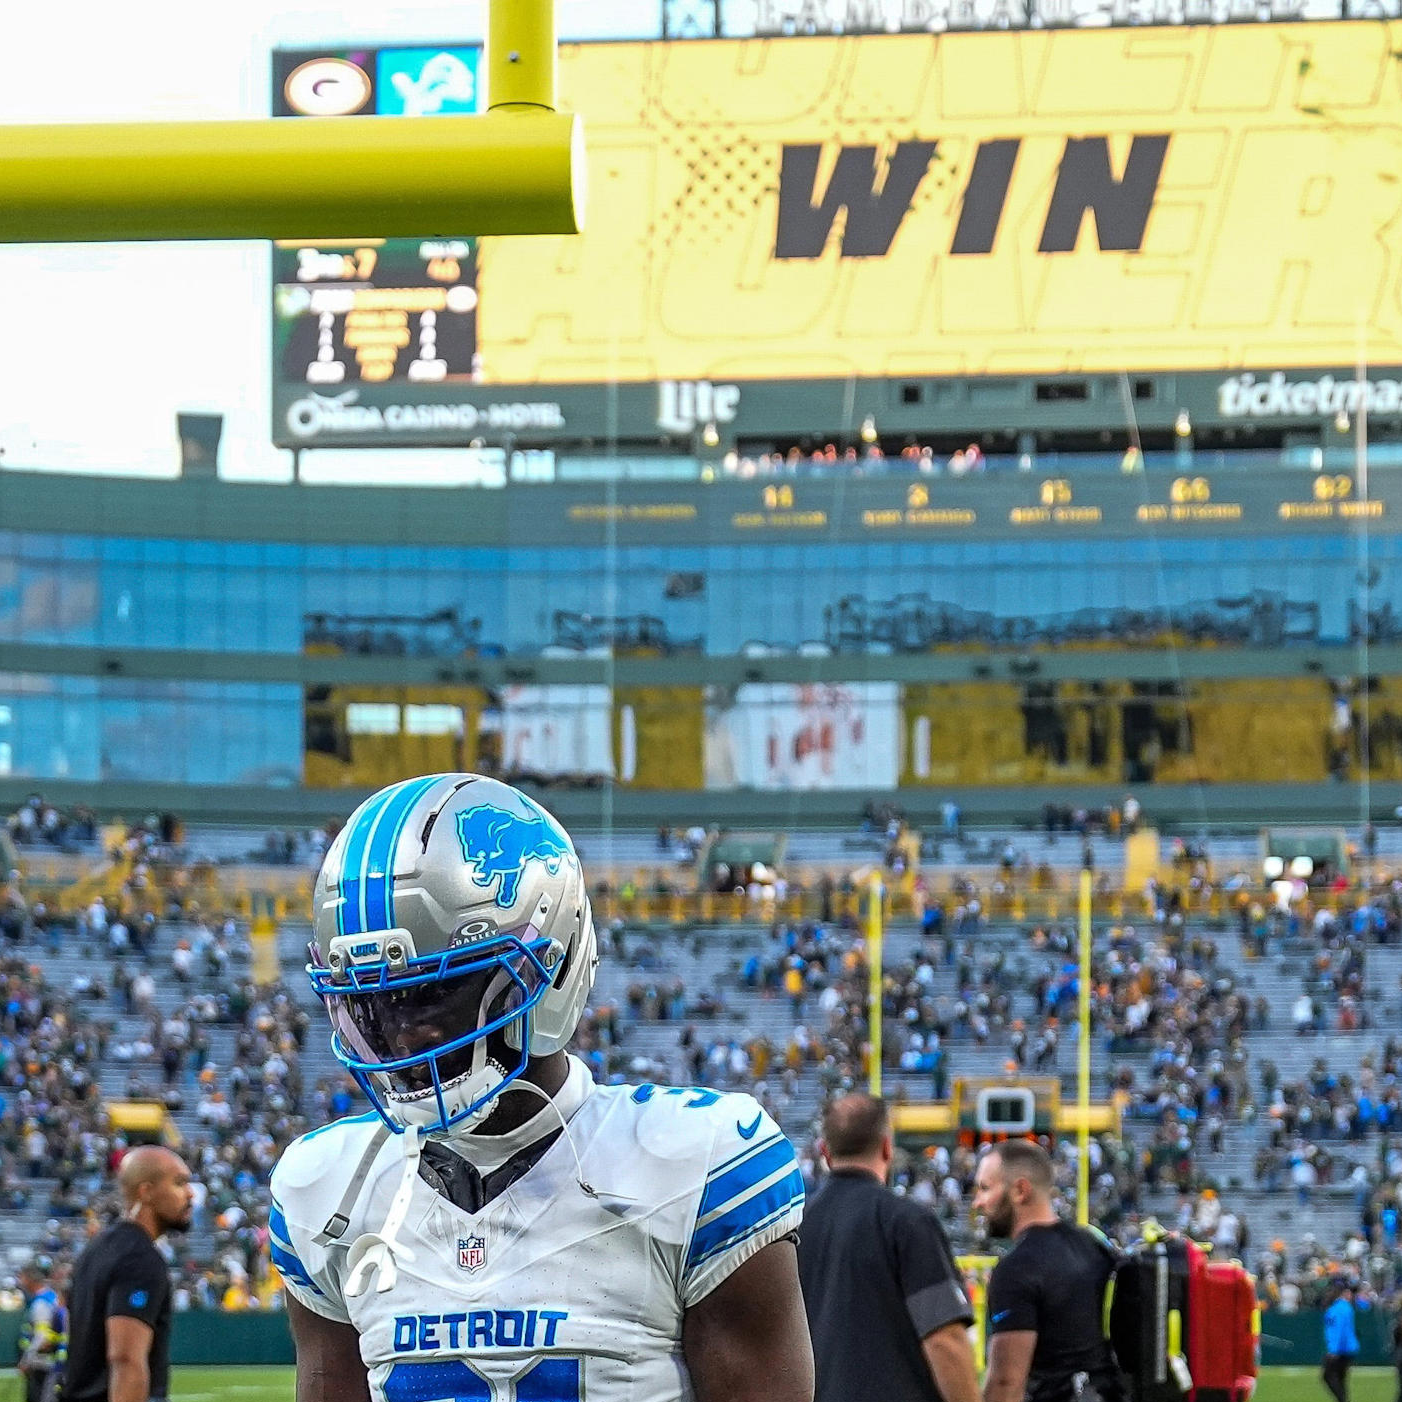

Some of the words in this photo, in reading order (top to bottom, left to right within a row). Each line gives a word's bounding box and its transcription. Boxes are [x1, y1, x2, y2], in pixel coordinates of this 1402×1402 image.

[774, 133, 1172, 258] WIN
[658, 379, 741, 433] Lite
[460, 1250, 484, 1266] NFL
[394, 1310, 568, 1351] DETROIT
